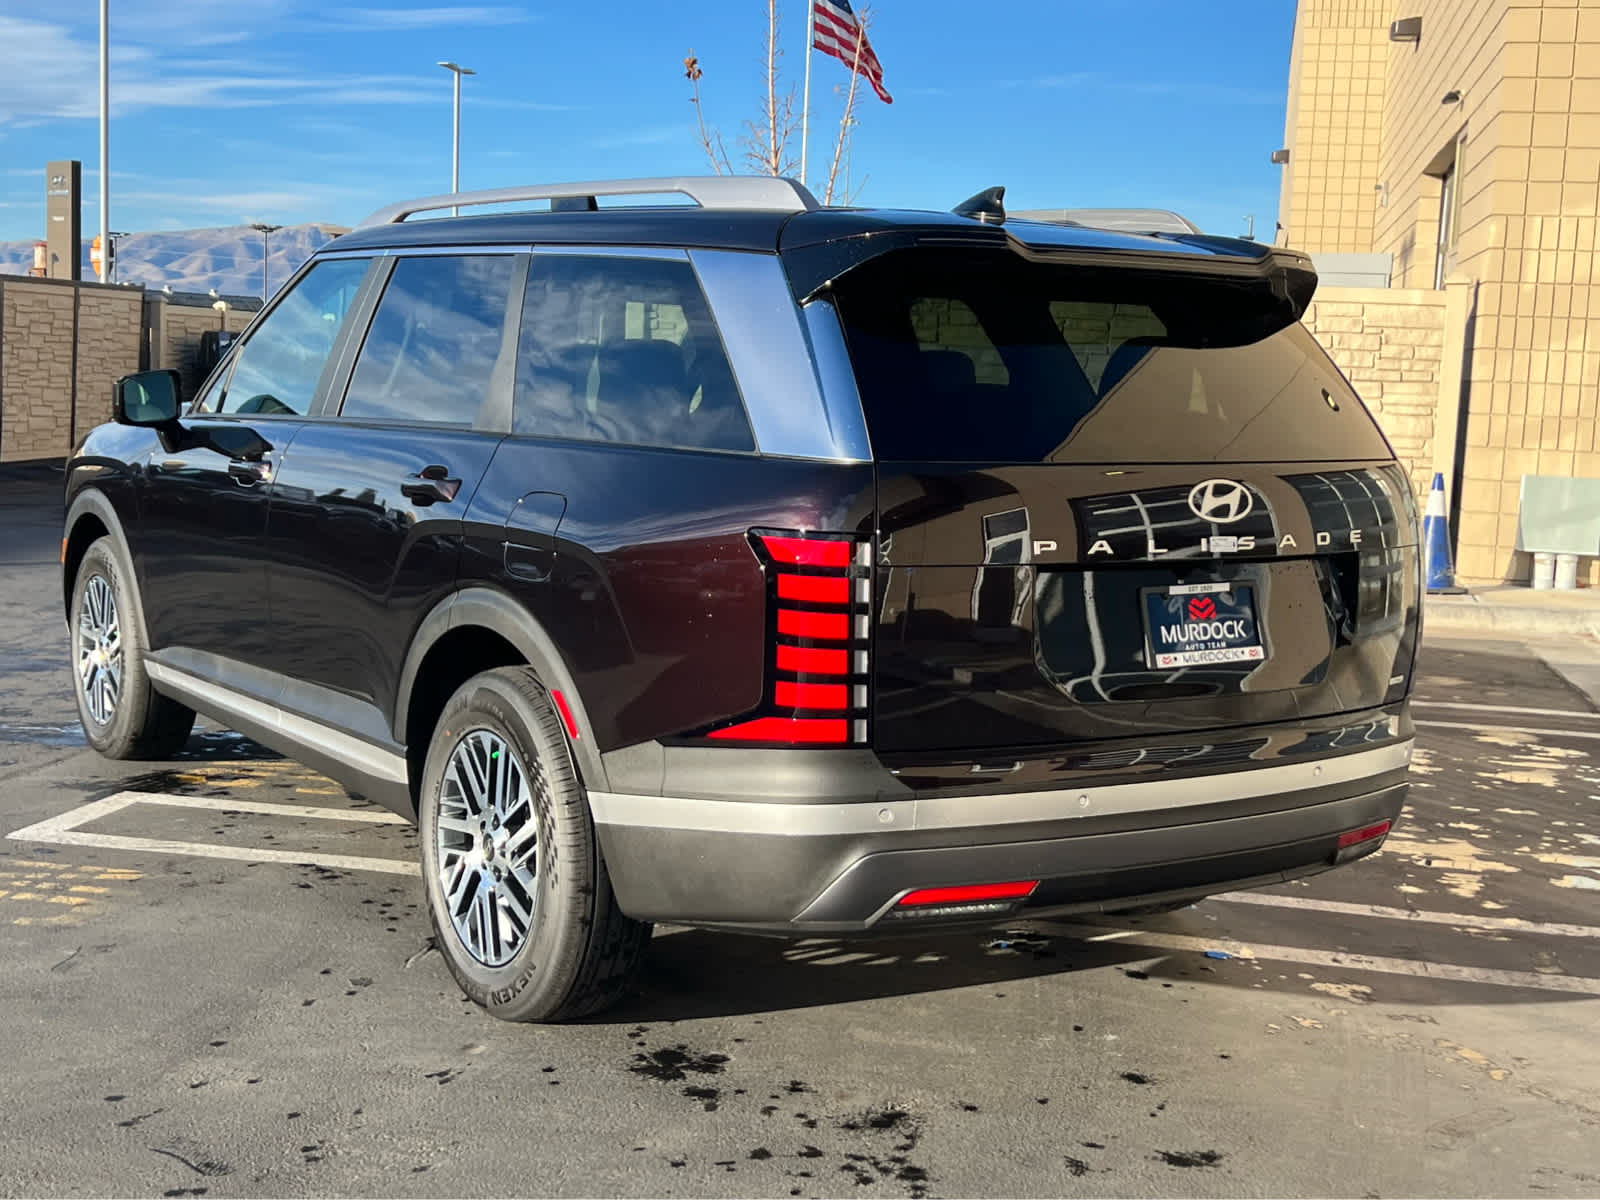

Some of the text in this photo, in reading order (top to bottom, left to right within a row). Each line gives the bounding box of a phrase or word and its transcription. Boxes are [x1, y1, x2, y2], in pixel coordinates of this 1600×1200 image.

[1033, 529, 1363, 555] PALISADE
[1161, 620, 1247, 643] MURDOCK
[1185, 641, 1227, 651] AUTO TEAM
[1182, 650, 1240, 663] MURDOCK
